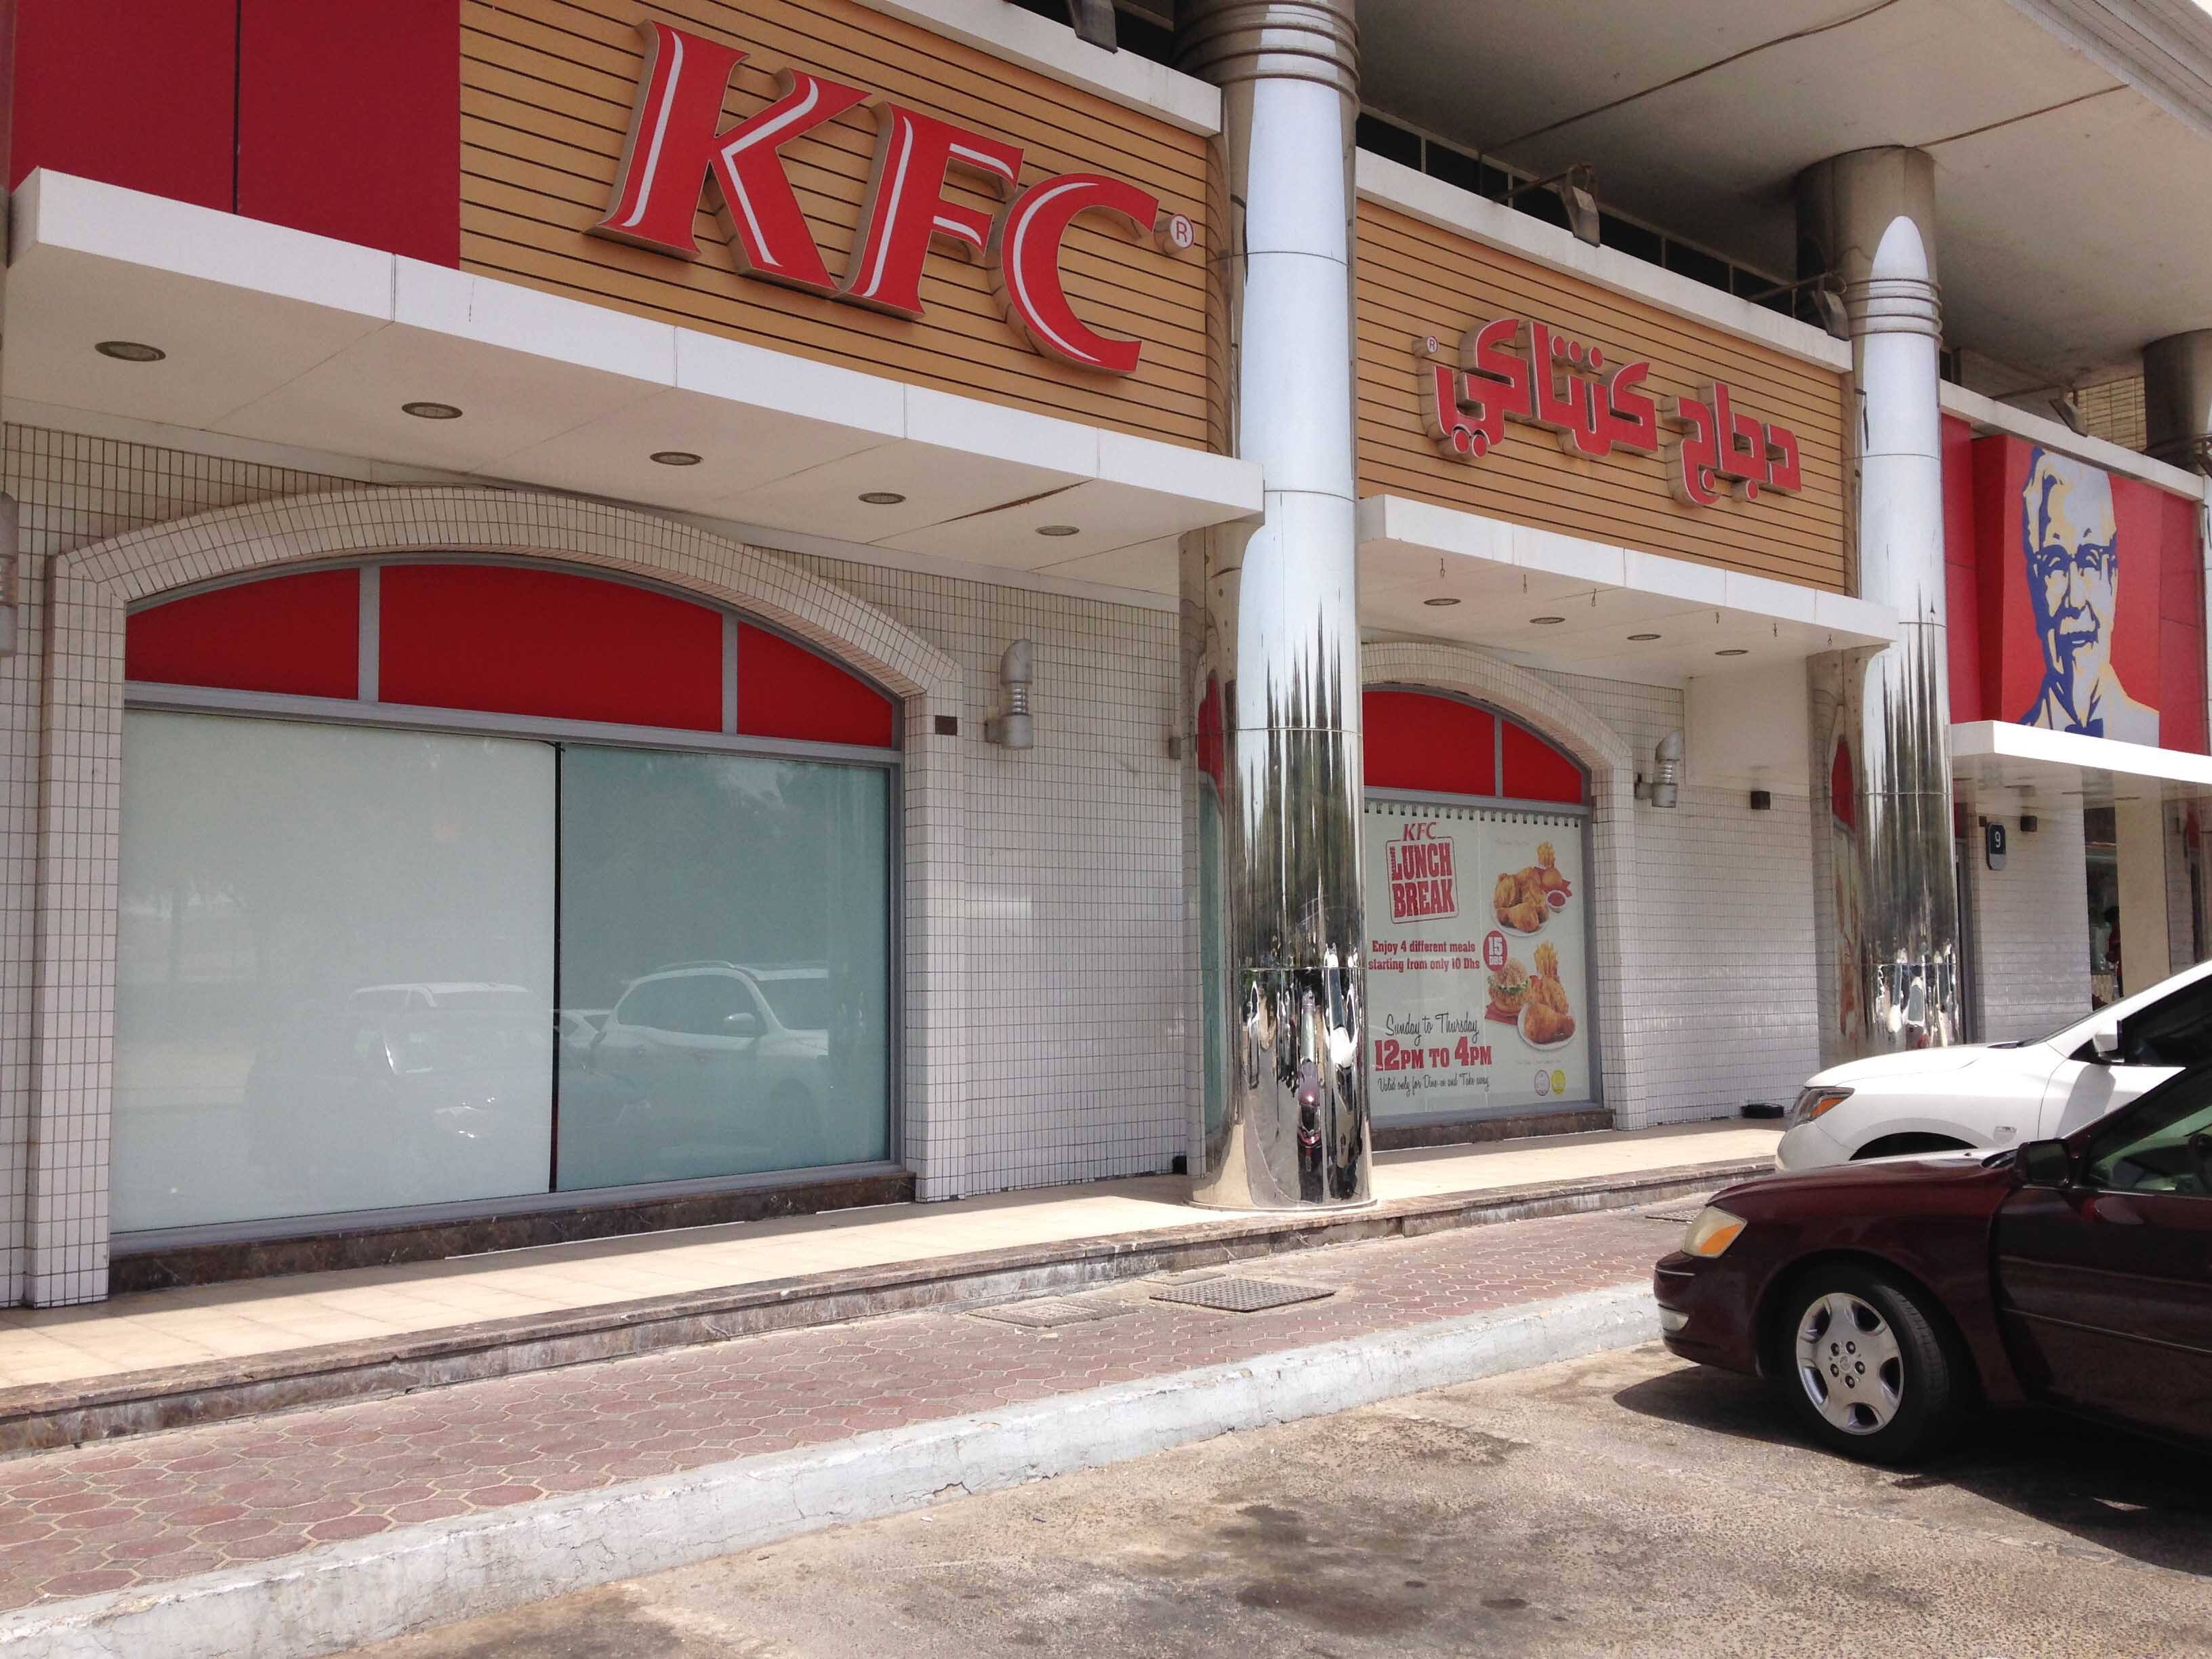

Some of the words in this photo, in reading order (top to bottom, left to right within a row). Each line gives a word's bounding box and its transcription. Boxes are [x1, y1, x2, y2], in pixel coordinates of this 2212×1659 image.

[580, 19, 1160, 377] KFC
[1433, 319, 1658, 458] كنتاكي
[1678, 381, 1803, 506] دجاج
[1403, 822, 1437, 841] KFC
[1994, 831, 2001, 848] 9
[1389, 842, 1452, 880] LUNCH
[1392, 878, 1455, 918] BREAK
[1372, 940, 1398, 955] Enjoy
[1400, 941, 1407, 952] 4
[1409, 941, 1447, 952] different
[1449, 941, 1475, 952] meals
[1488, 937, 1503, 955] 15
[1368, 959, 1404, 972] starting
[1407, 959, 1427, 970] from
[1430, 958, 1450, 972] only
[1452, 958, 1461, 969] 10
[1464, 958, 1480, 969] Dhs
[1385, 1013, 1422, 1046] Sunday
[1422, 1016, 1433, 1034] to
[1435, 1012, 1480, 1044] Thursday
[1374, 1039, 1425, 1071] 12PM
[1429, 1048, 1450, 1068] TO
[1454, 1036, 1492, 1066] 4PM
[1397, 1076, 1411, 1097] only
[1411, 1076, 1422, 1095] for
